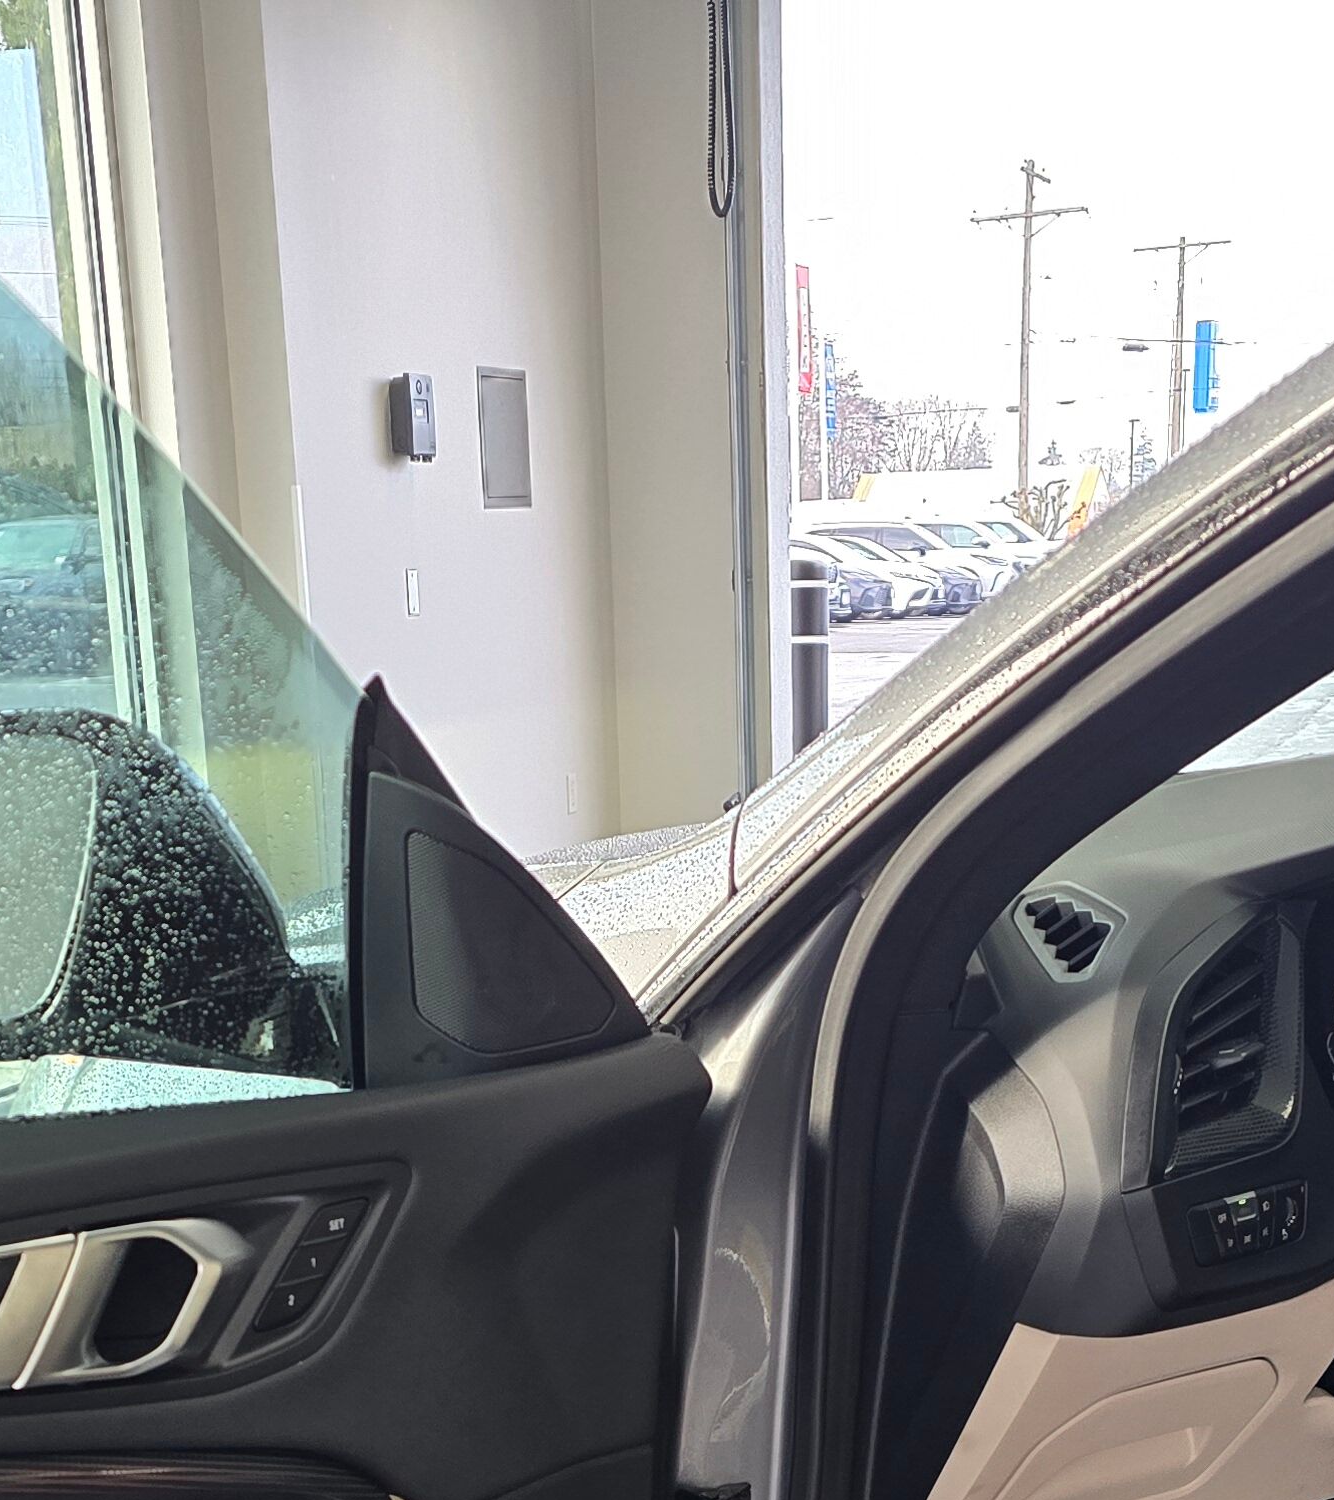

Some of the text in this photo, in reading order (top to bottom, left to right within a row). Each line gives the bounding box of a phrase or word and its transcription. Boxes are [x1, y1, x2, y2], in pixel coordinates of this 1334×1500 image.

[329, 1218, 345, 1231] SET
[311, 1257, 316, 1268] 1
[288, 1294, 295, 1306] 2
